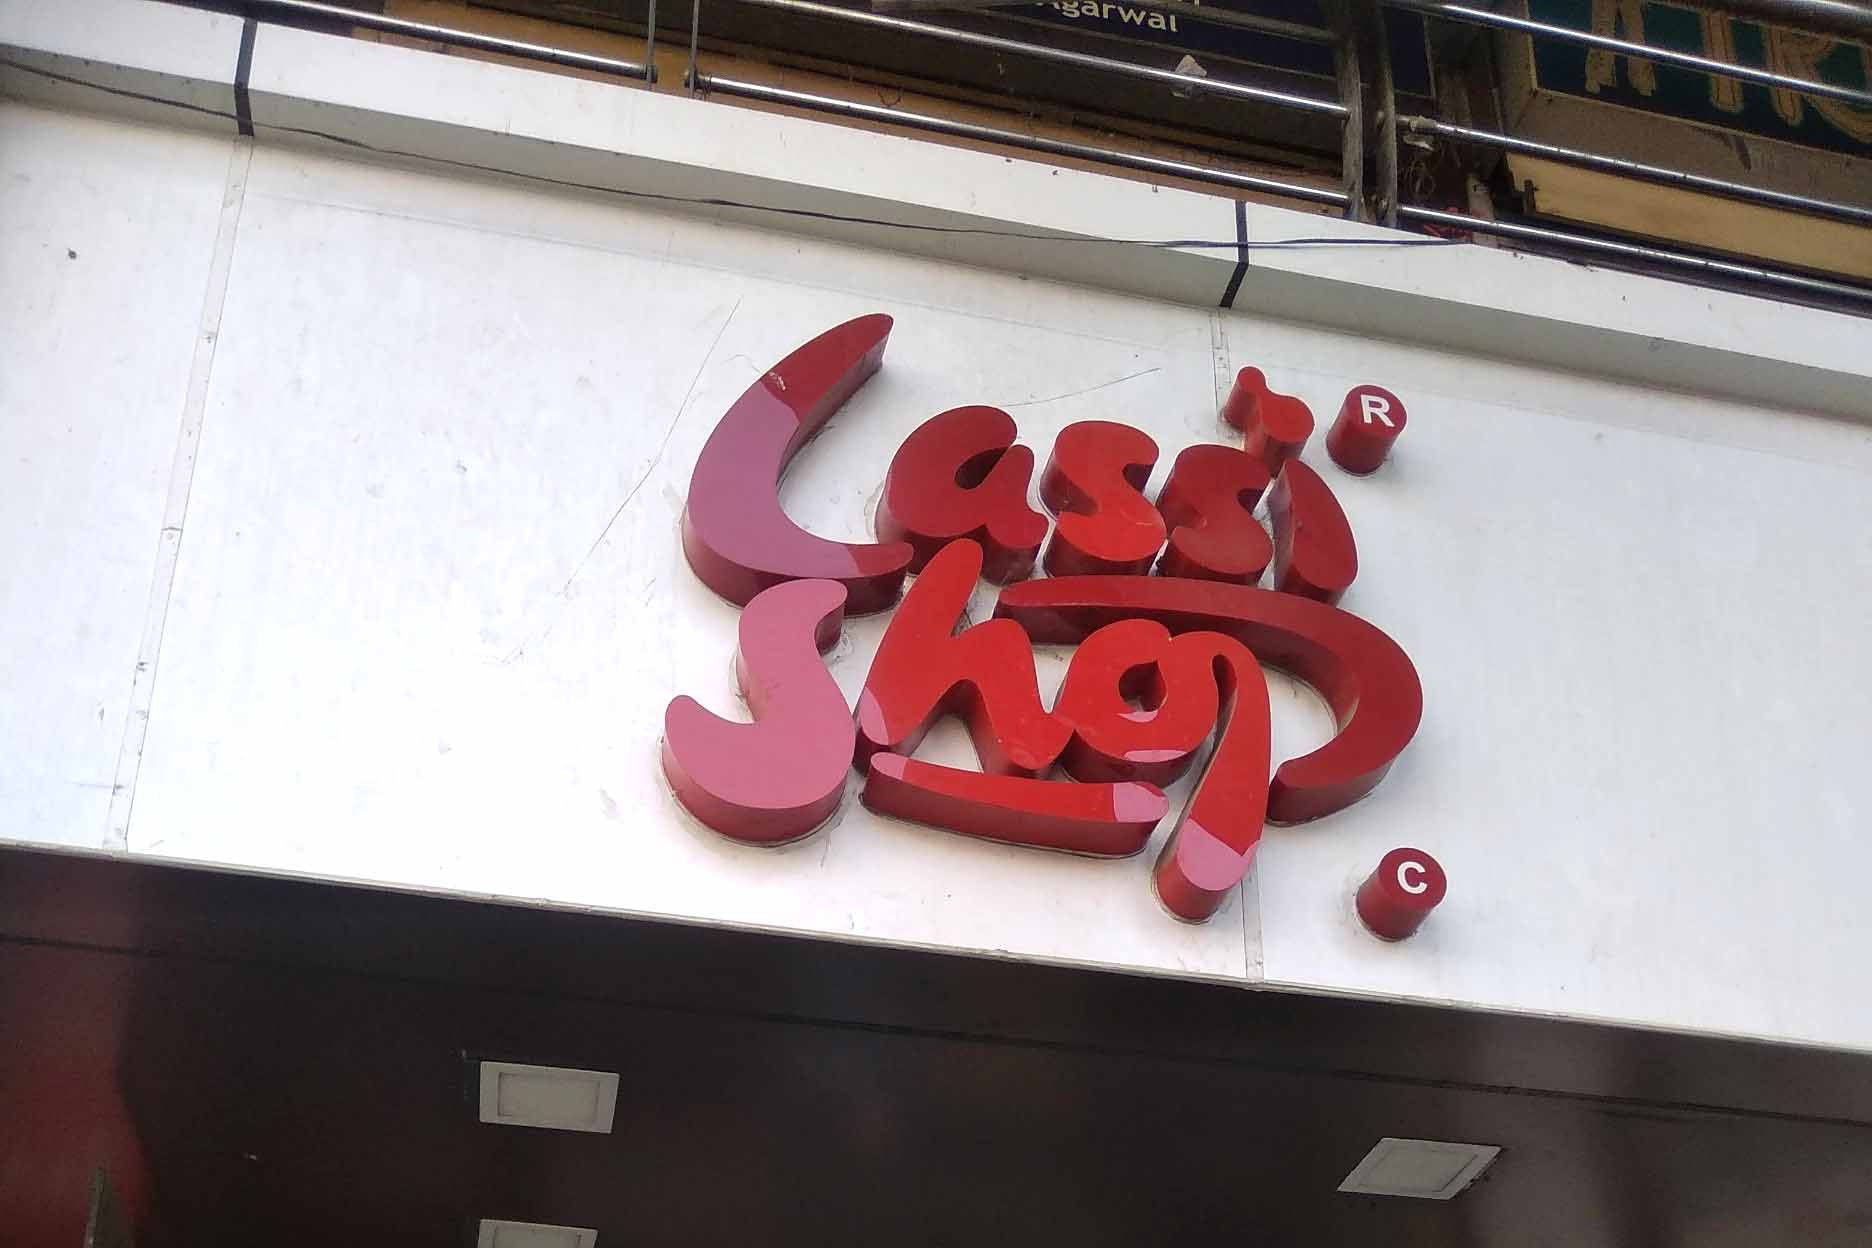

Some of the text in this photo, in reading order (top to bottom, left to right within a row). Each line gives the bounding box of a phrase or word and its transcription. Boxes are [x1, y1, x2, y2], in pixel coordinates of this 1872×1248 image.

[1037, 0, 1178, 32] garwal
[683, 313, 1358, 612] Lassi
[662, 539, 1423, 920] Shop
